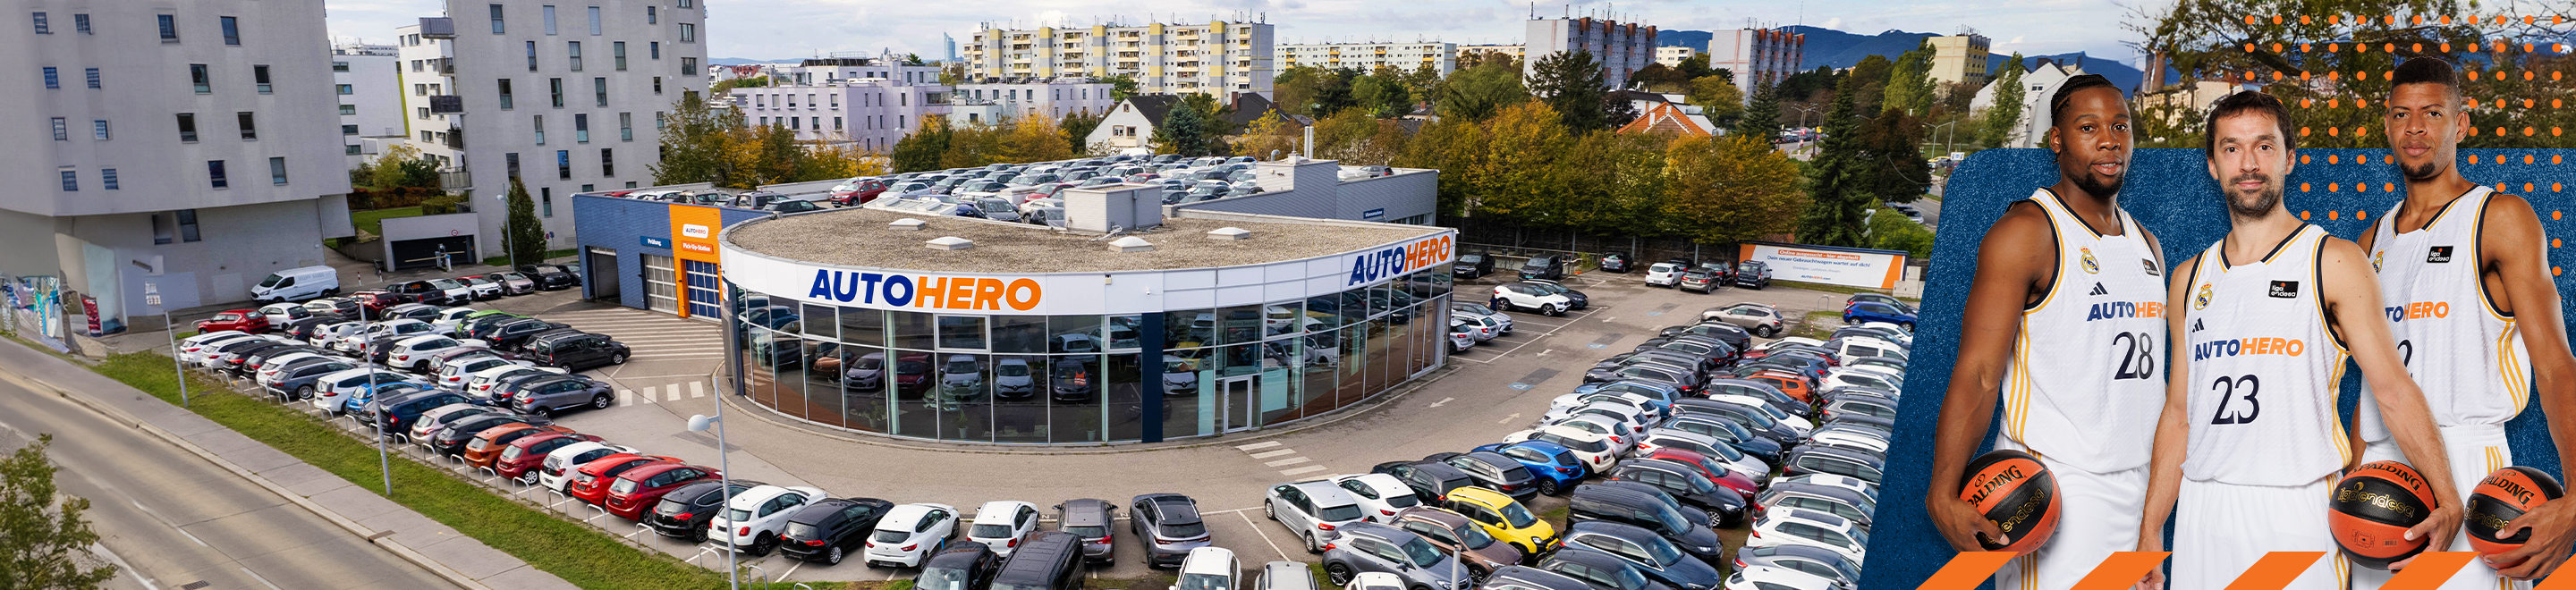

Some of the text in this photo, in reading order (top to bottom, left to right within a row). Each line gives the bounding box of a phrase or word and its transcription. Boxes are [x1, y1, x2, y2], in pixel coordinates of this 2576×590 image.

[648, 238, 662, 247] Prüfung
[686, 227, 707, 235] AUTOHERO
[682, 242, 711, 252] Pick-Up-Station
[1348, 235, 1451, 286] AUTOHERO
[1792, 257, 1832, 265] Gebrauchtwagen
[809, 269, 1042, 311] AUTOHERO
[2385, 301, 2449, 323] TOHERO
[2113, 331, 2154, 380] 28
[2194, 337, 2304, 362] AUTOHERO
[2211, 375, 2260, 425] 23
[1967, 465, 2024, 508] PALDING
[2001, 488, 2045, 532] endesa
[2359, 492, 2415, 518] endesa
